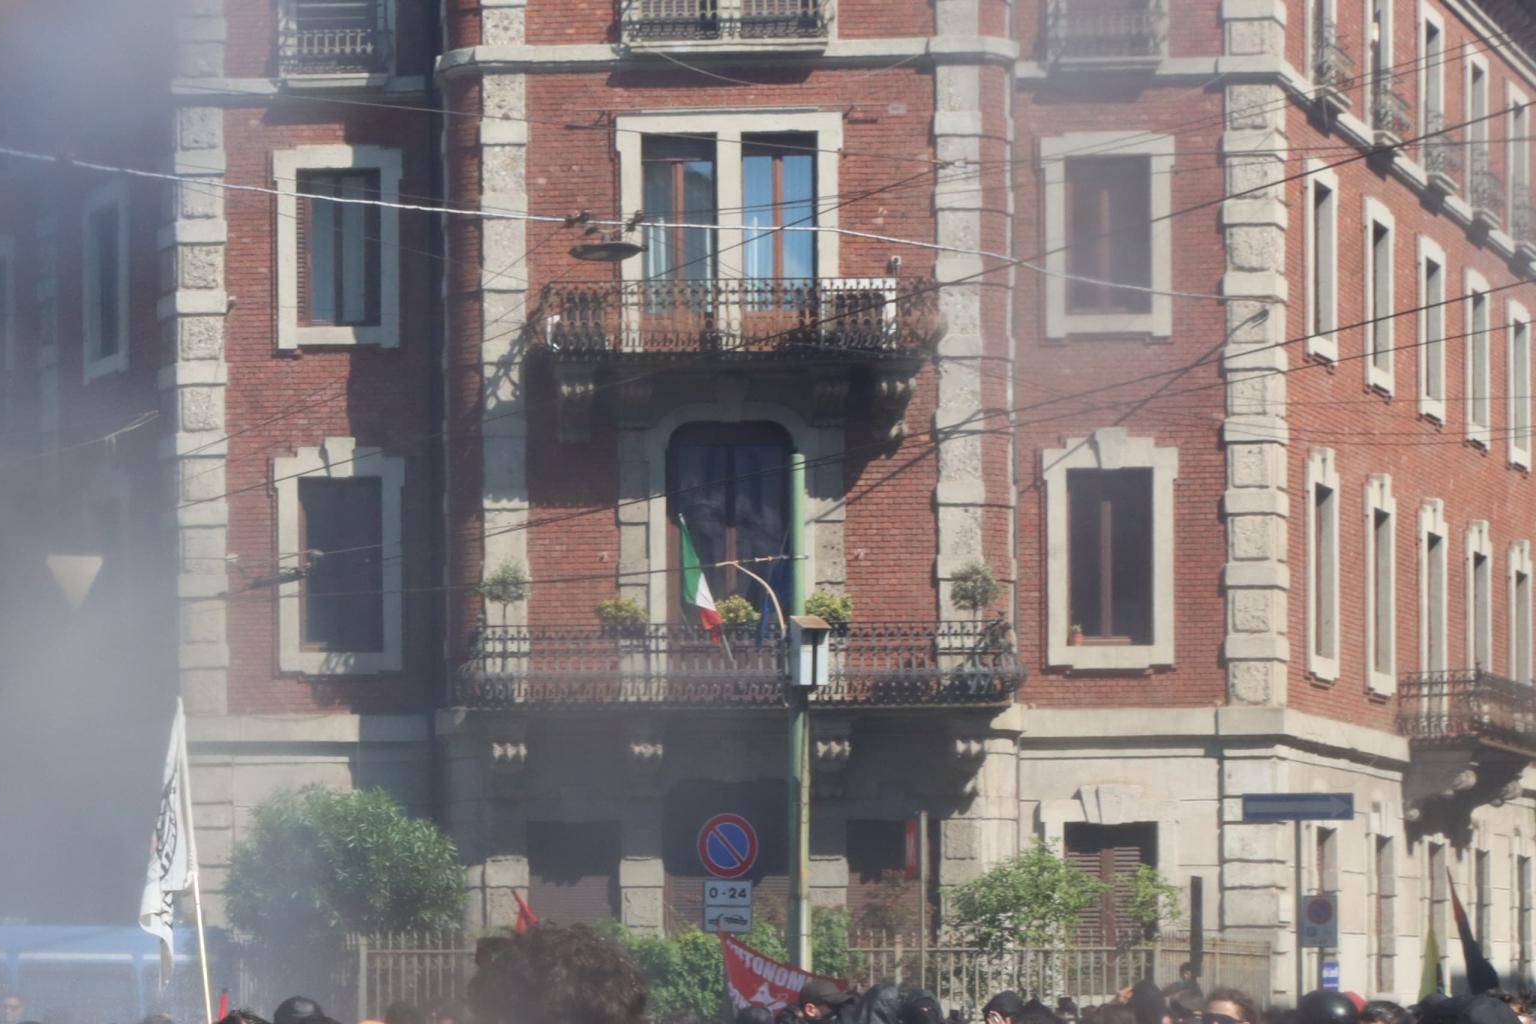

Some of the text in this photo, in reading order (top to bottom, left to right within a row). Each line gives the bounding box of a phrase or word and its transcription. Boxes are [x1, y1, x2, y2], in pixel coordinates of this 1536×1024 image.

[709, 887, 718, 899] 0
[729, 887, 747, 899] 24
[725, 938, 808, 993] TONOM
